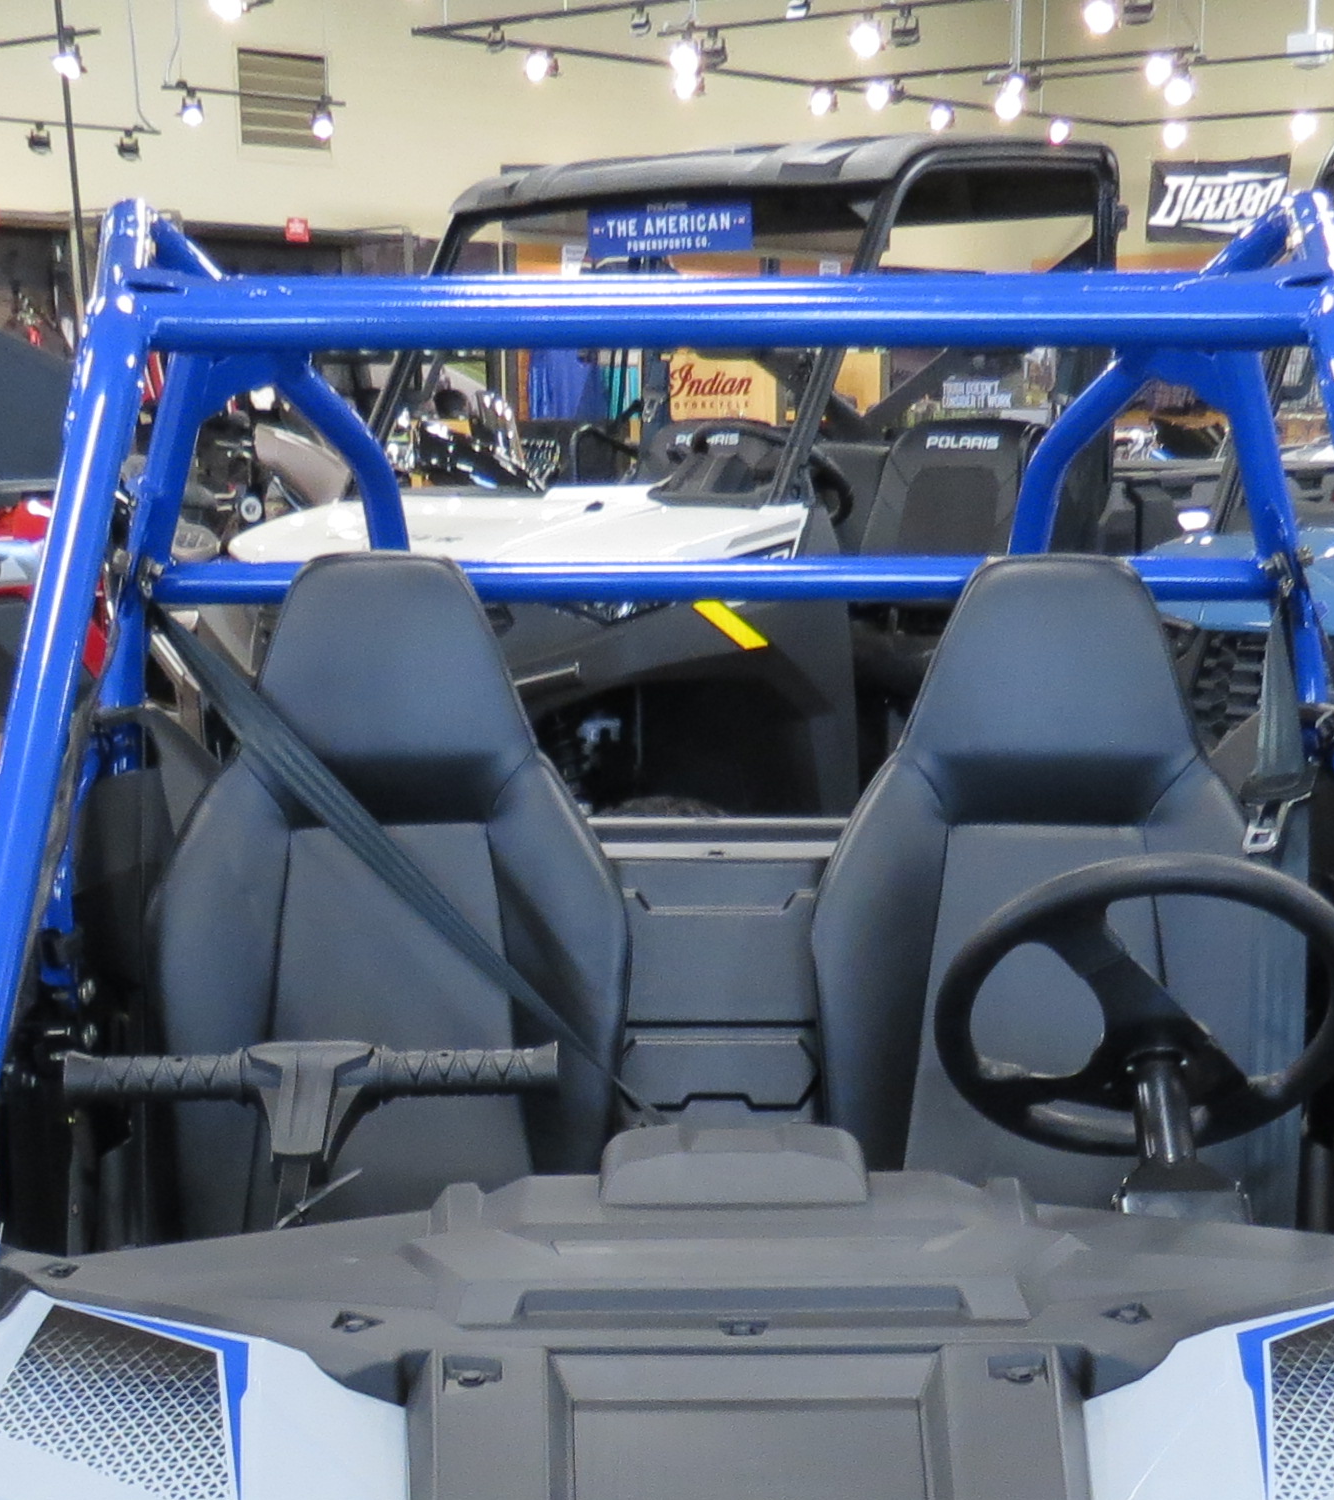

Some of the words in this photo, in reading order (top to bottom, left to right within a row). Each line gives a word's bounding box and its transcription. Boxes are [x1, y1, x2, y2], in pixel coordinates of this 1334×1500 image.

[607, 217, 638, 239] THE
[644, 212, 731, 237] AMERICAN
[670, 362, 752, 397] Indian
[673, 400, 750, 410] OTORCYCLE
[926, 434, 1000, 450] POLARIS
